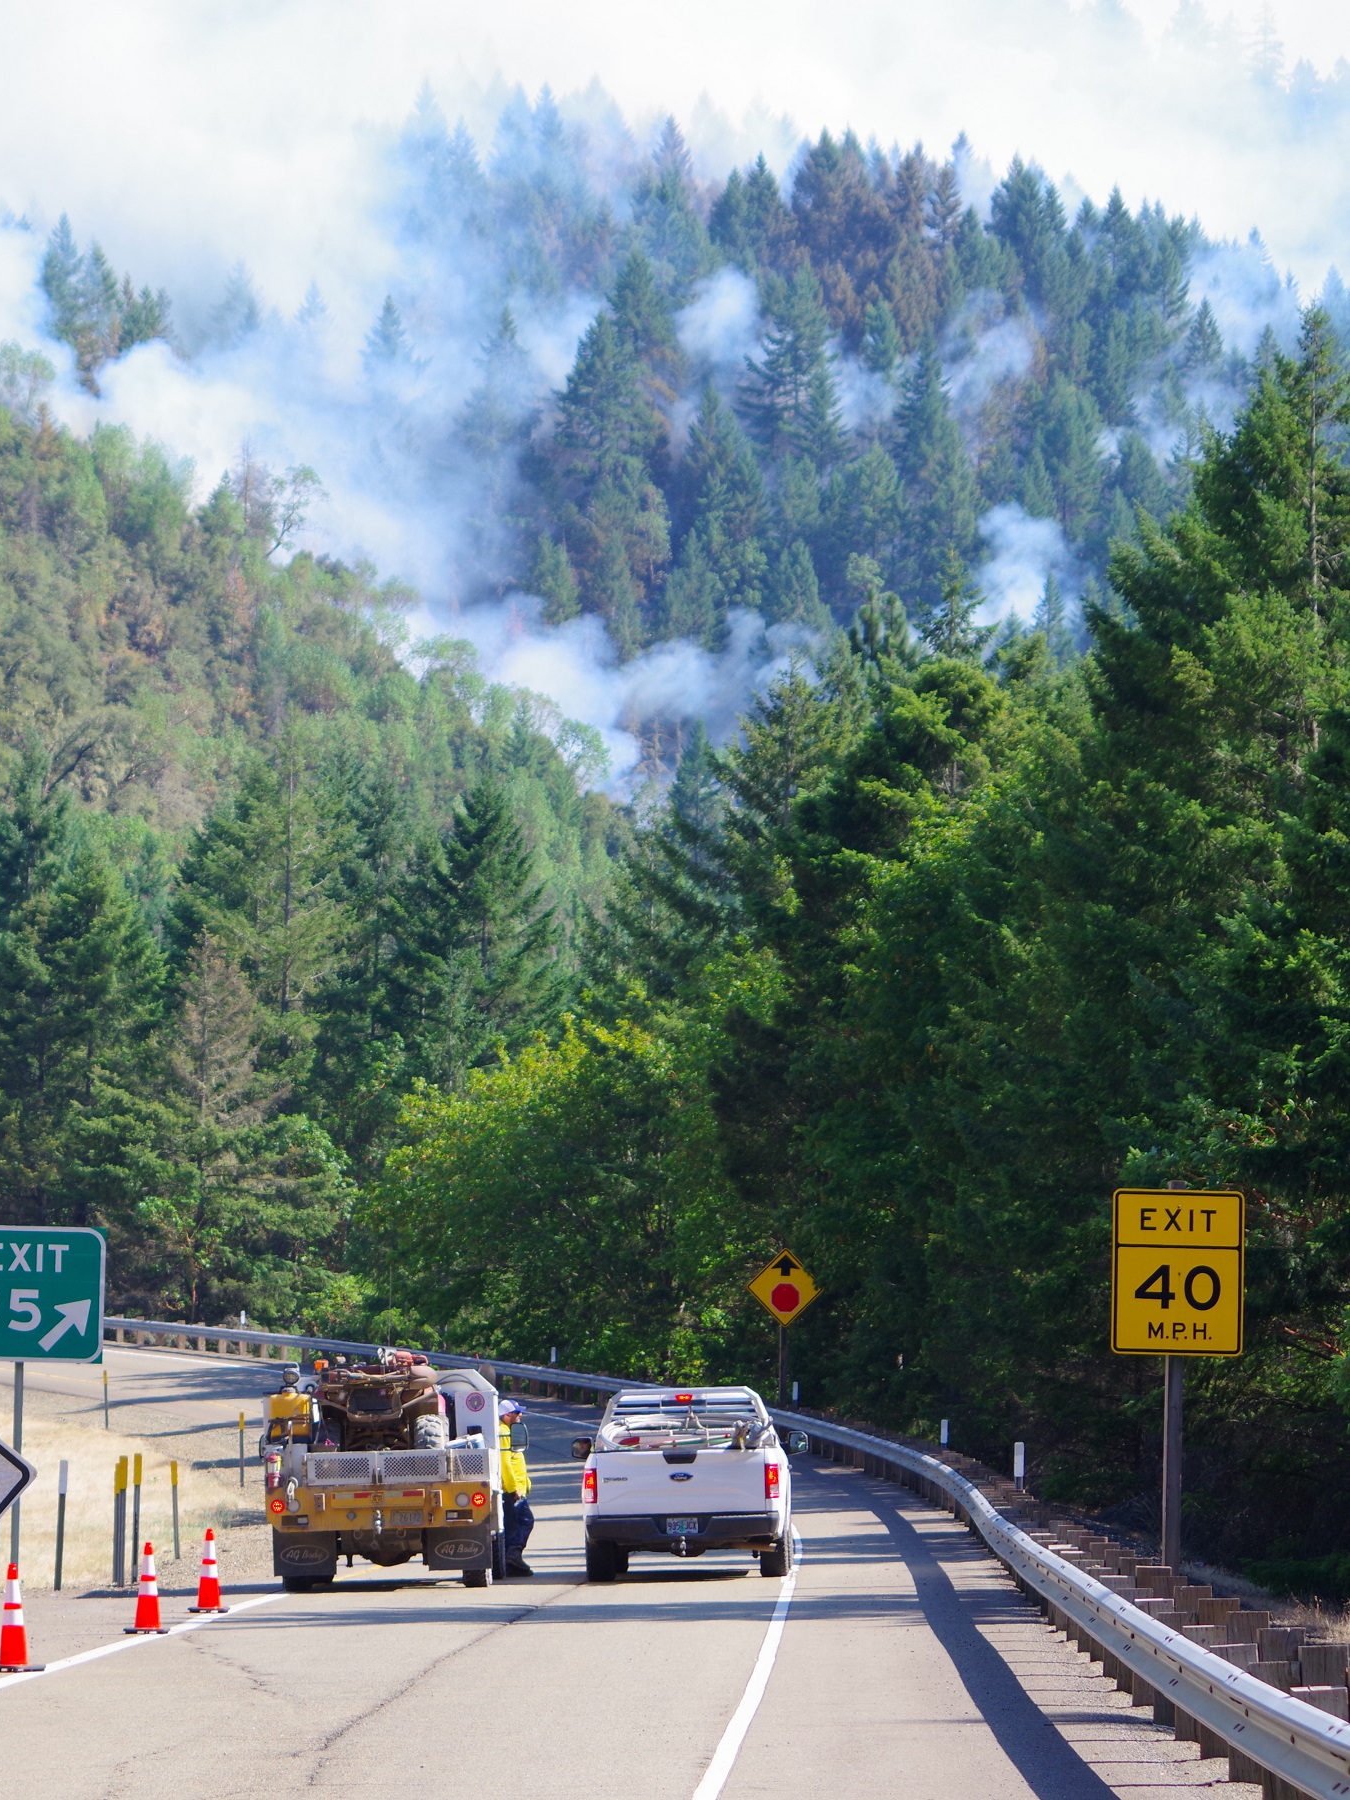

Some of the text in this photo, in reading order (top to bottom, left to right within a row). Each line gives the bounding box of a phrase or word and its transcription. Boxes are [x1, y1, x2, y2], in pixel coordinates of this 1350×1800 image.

[1140, 1208, 1217, 1232] EXIT
[1134, 1264, 1221, 1311] 40
[1148, 1321, 1213, 1340] M.P.H.
